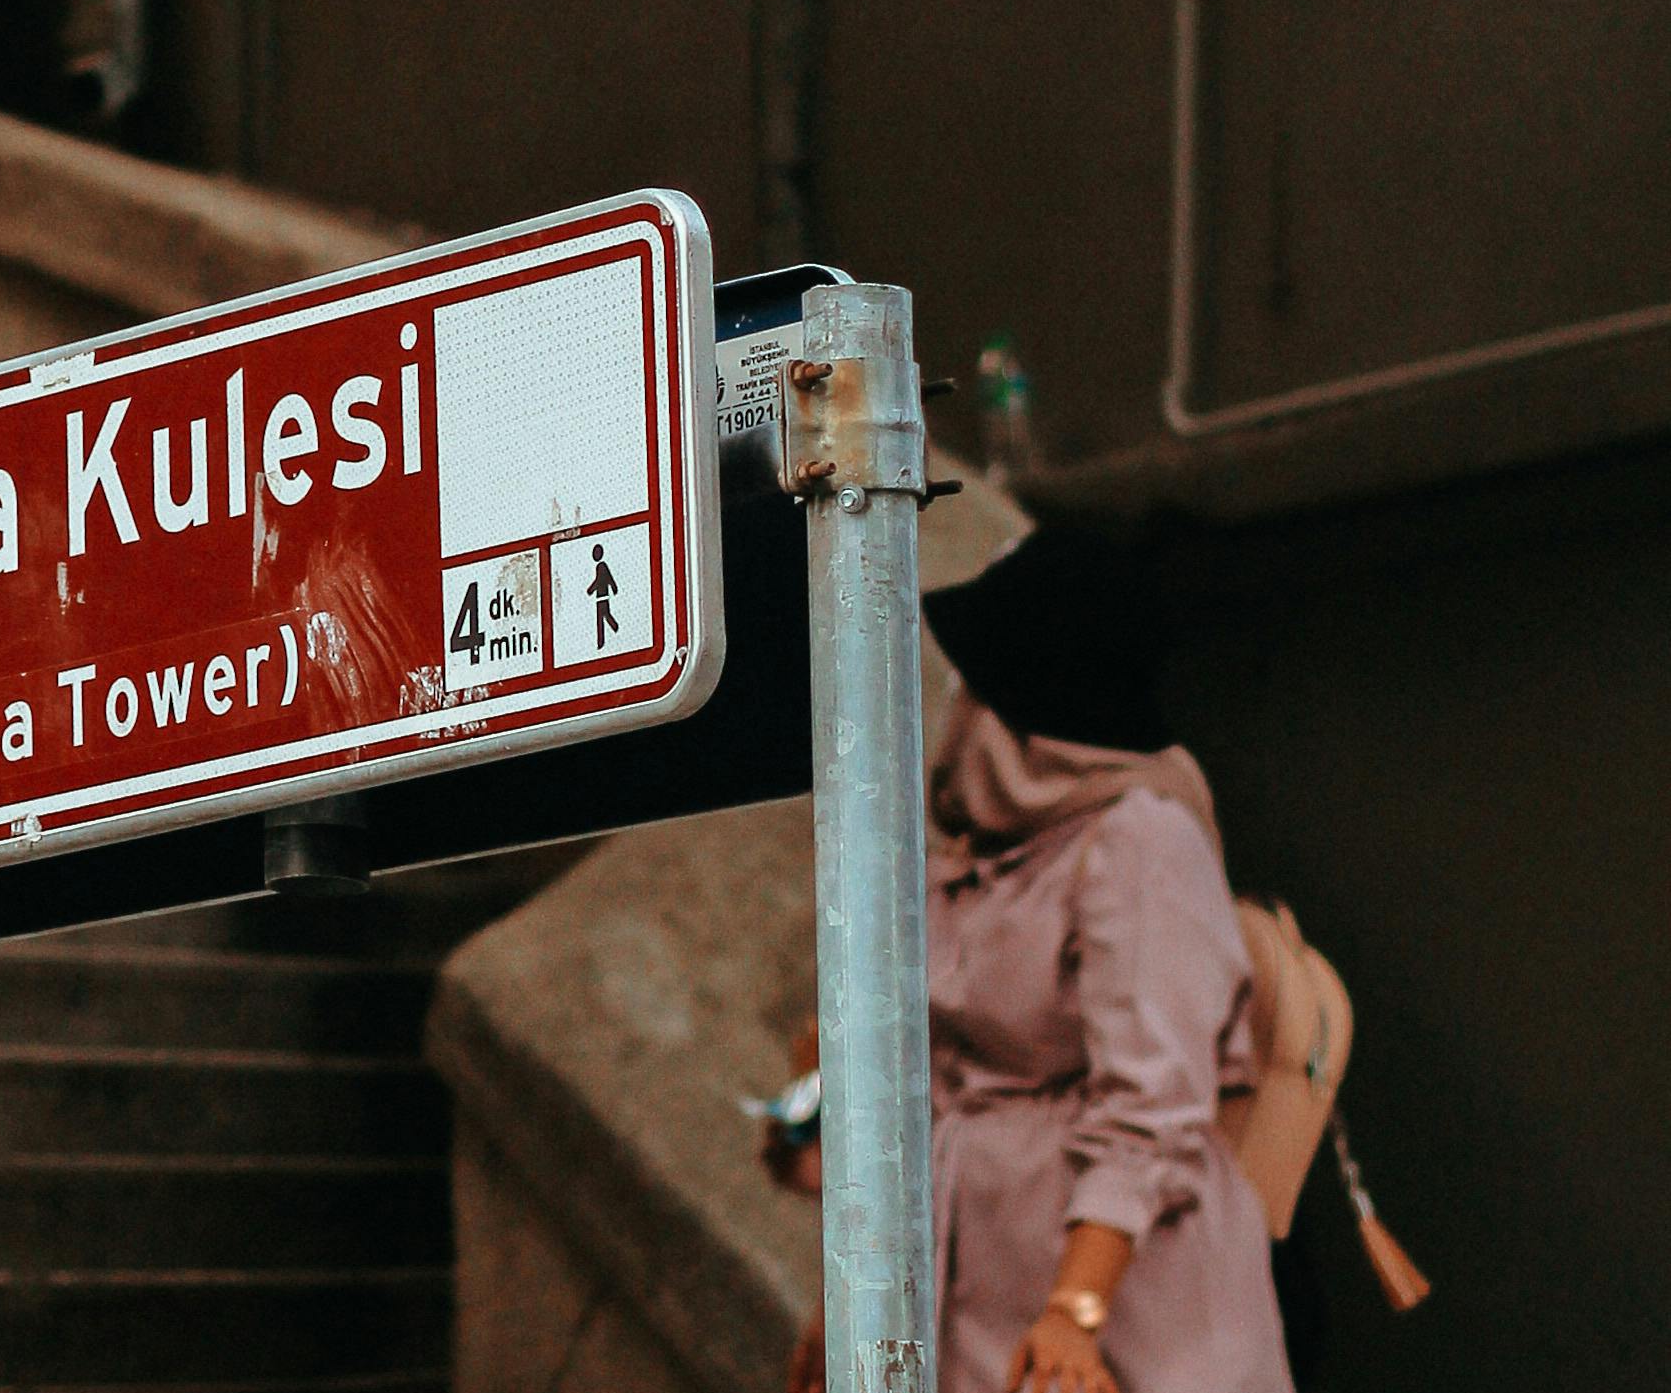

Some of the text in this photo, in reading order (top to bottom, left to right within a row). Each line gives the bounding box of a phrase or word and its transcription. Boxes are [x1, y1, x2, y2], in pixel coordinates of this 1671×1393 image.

[750, 340, 780, 354] İSTANBUL
[67, 322, 422, 557] Kulesi
[450, 581, 520, 665] 4 dk.
[489, 626, 538, 661] min.
[58, 624, 299, 747] Tower)
